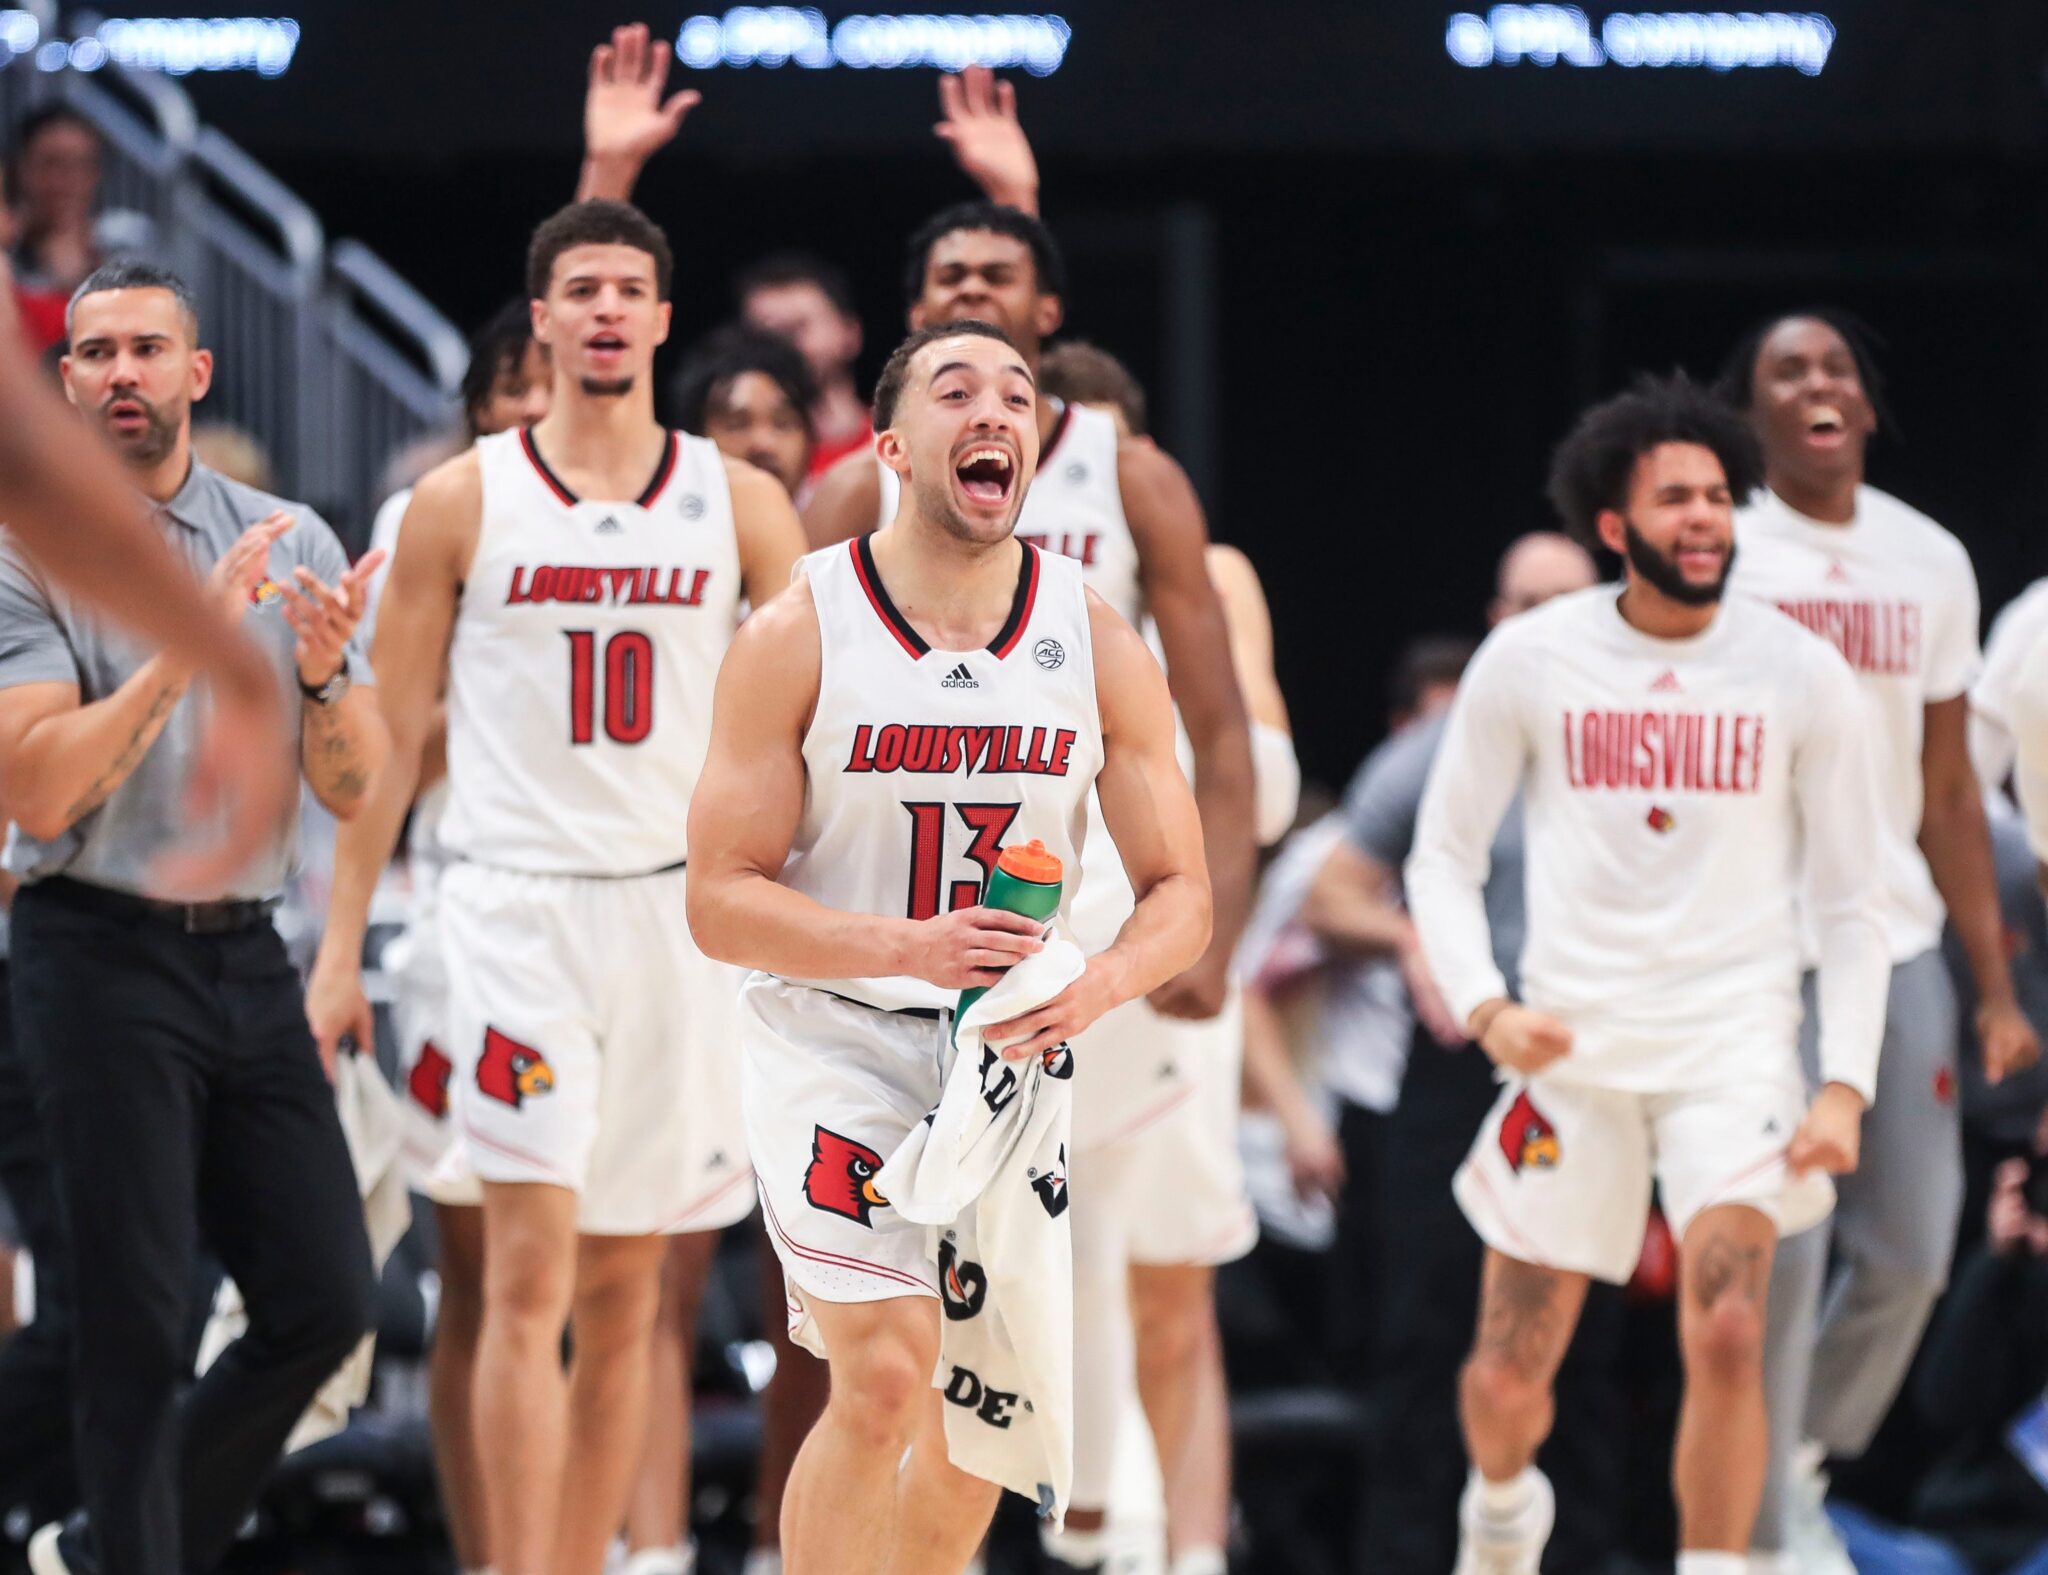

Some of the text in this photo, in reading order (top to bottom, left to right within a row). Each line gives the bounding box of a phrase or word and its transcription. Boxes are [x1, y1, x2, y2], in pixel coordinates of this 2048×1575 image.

[505, 565, 711, 607] LOUISVILLE
[563, 630, 654, 745] 10
[941, 678, 979, 689] adidas
[843, 723, 1077, 779] LOUISVILLE
[1563, 711, 1751, 793] LOUISVILLE
[901, 801, 1022, 919] 13
